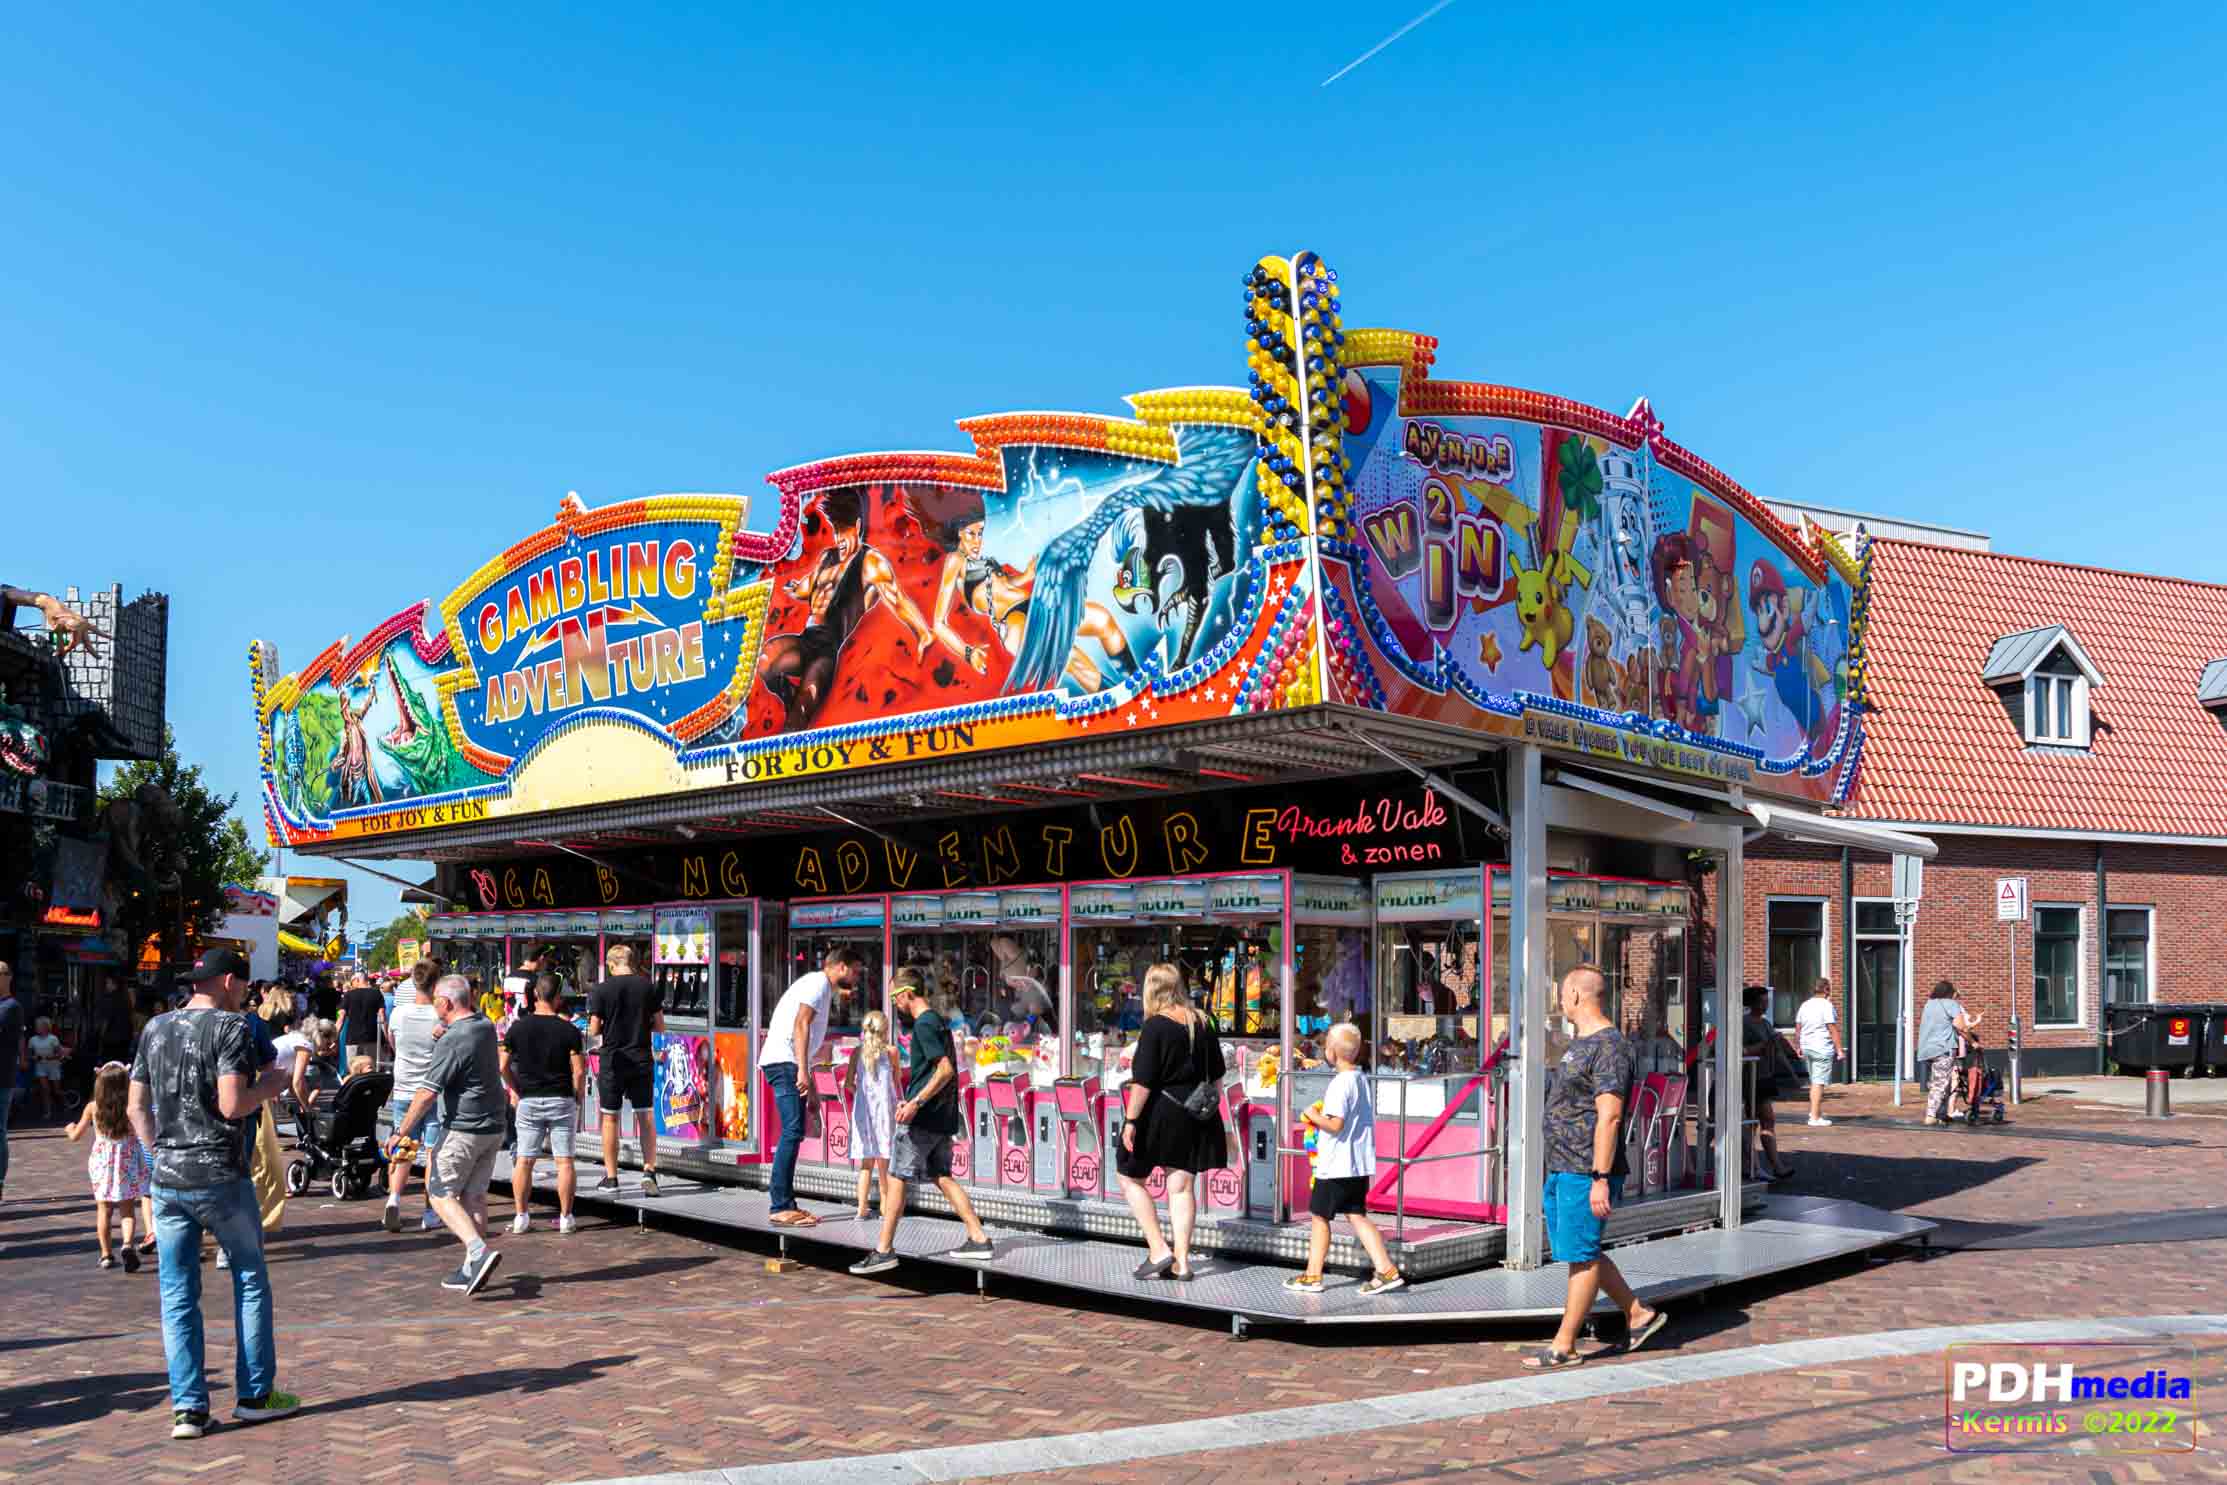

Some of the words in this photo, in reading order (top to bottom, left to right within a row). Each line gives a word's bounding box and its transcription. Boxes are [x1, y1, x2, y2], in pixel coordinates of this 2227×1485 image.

[1405, 422, 1510, 477] ADVENTURE
[1426, 486, 1450, 525] 2
[1370, 511, 1497, 603] WIN
[478, 539, 696, 654] GAMBLING
[485, 605, 706, 726] ADVENTURE
[725, 756, 784, 783] FOR
[794, 743, 856, 772] JOY
[868, 739, 892, 761] &
[904, 724, 976, 756] FUN
[361, 817, 391, 833] FOR
[396, 811, 428, 828] JOY
[433, 808, 446, 822] &
[450, 801, 485, 819] FUN
[1277, 800, 1376, 844] Frank
[1376, 787, 1448, 832] Vale
[795, 808, 1278, 893] ADVENTURE
[1341, 843, 1358, 865] &
[1364, 843, 1441, 863] zonen
